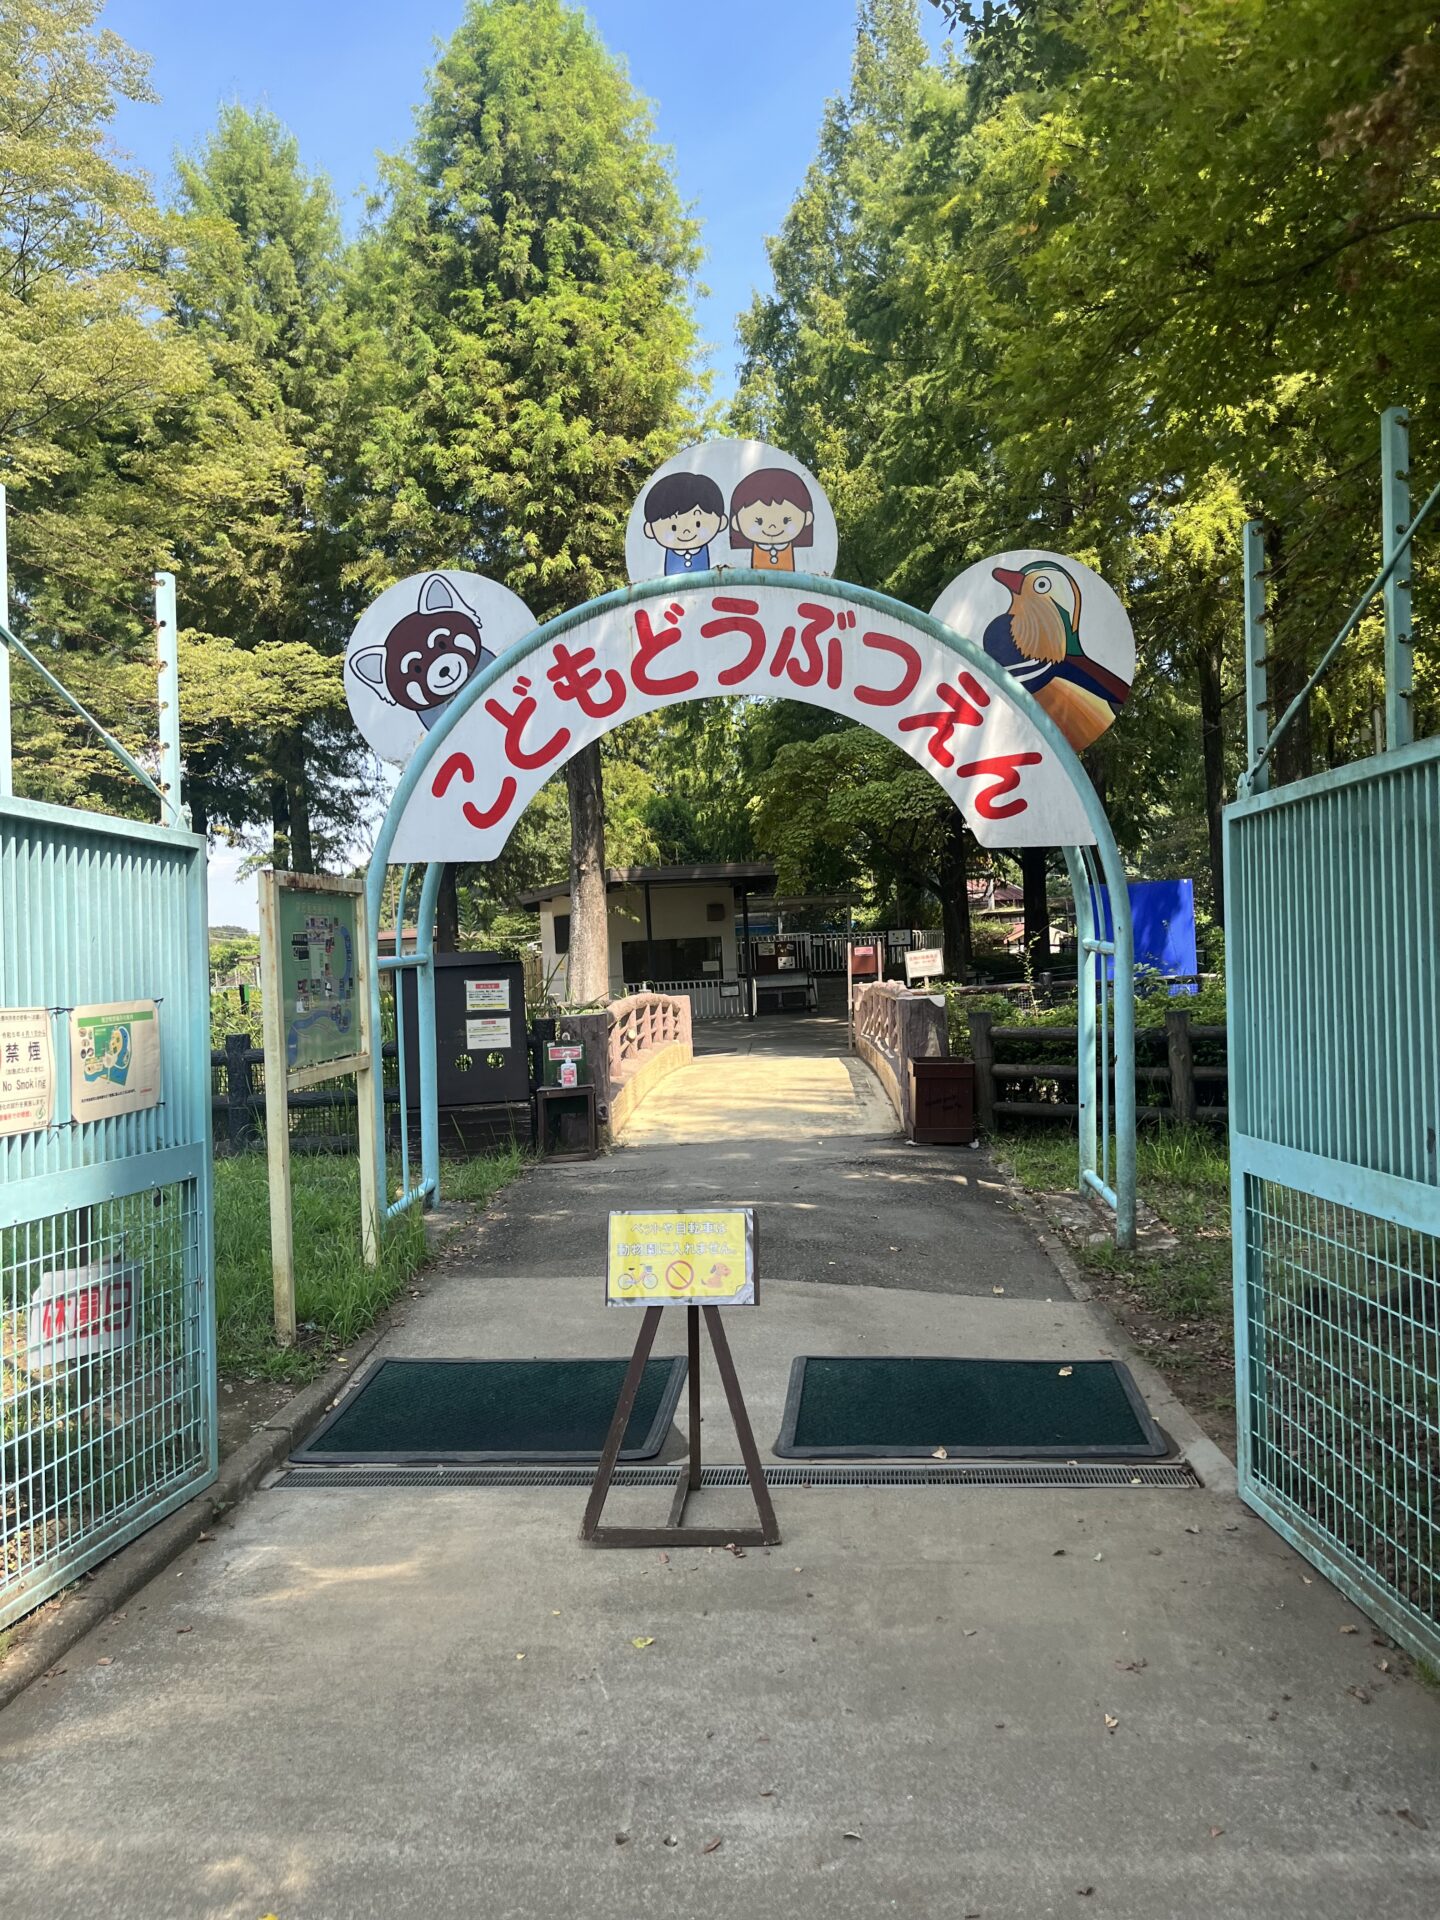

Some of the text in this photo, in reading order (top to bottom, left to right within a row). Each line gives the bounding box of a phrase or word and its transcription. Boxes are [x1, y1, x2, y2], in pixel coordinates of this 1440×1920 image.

[432, 597, 1043, 830] こどもどうぶつえん
[5, 1041, 42, 1063] 禁煙
[2, 1077, 46, 1092] No Smoking
[631, 1221, 728, 1235] ペットや自転車は
[617, 1242, 738, 1256] 動物園に入れません。
